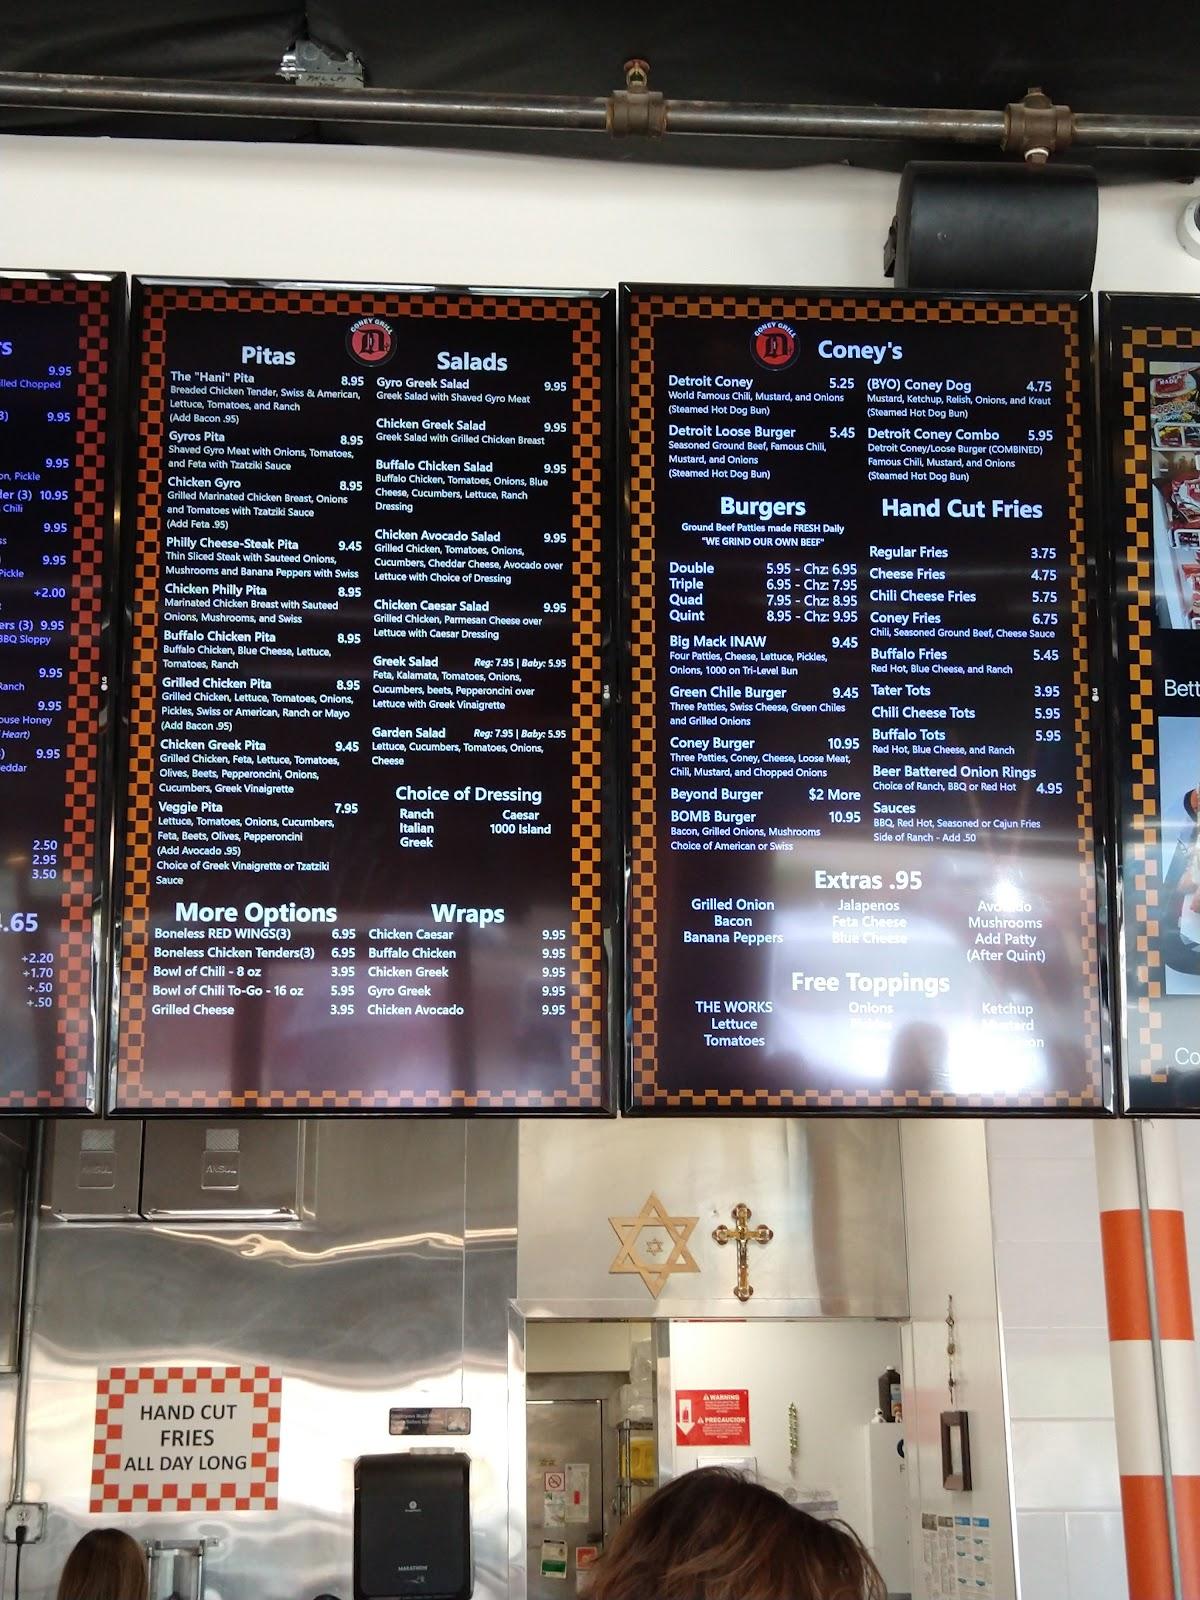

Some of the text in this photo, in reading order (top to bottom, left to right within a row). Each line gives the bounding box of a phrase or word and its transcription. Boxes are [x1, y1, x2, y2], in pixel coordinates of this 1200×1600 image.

[241, 345, 295, 365] Pitas
[818, 340, 903, 364] Coney's
[437, 351, 507, 371] Salads
[48, 366, 71, 376] 9.95
[19, 379, 61, 390] Chopped
[170, 371, 364, 386] The "Hani" Pita 8.95
[376, 377, 566, 391] Gyro Greek Salad 9.95
[668, 375, 854, 390] Detroit Coney 5.25
[867, 378, 1051, 393] (BYO) Coney Dog 4.75
[170, 385, 360, 399] Breaded Chicken Tender, Swiss & American,
[376, 390, 530, 404] Greek Salad with Shaved Gyro Meat
[47, 412, 70, 422] 9.95
[867, 407, 968, 418] (Steamed Hot Dog Bun)
[168, 430, 363, 445] Gyros Pita 8.95
[45, 457, 69, 468] 9.95
[376, 459, 566, 473] Buffalo Chicken Salad 9.95
[14, 471, 40, 480] Pickle
[167, 476, 362, 490] Chicken Gyro 8.95
[17, 489, 68, 501] (3) 10.95
[720, 496, 806, 521] Burgers
[882, 498, 1042, 518] Hand Cut Fries
[43, 522, 67, 532] 9.95
[165, 536, 362, 550] Philly Cheese-Steak Pita 9.45
[869, 545, 1056, 560] Regular Fries 3.75
[42, 555, 66, 565] 9.95
[33, 587, 65, 597] +2.00
[18, 620, 64, 631] (3) 9.95
[19, 634, 51, 645] Sloppy
[670, 635, 858, 649] Big Mack INAW 9.45
[373, 655, 438, 667] Greek Salad
[38, 668, 62, 677] 9.95
[373, 670, 521, 681] Feta, Kalamata, Tomatoes, Onions,
[37, 700, 61, 710] 9.95
[22, 715, 52, 726] Honey
[35, 748, 60, 758] 9.95
[873, 765, 1036, 780] Beer Battered Onion Rings
[1036, 782, 1062, 793] 4.95
[395, 785, 541, 805] Choice of Dressing
[670, 787, 861, 802] Beyond Burger $2 More
[158, 801, 358, 814] Veggie Pita 7.95
[400, 808, 434, 819] Ranch
[502, 809, 539, 820] Caesar
[399, 822, 434, 833] Italian
[489, 823, 551, 834] 1000 Island
[32, 840, 57, 850] 2.50
[400, 836, 433, 847] Greek
[32, 854, 56, 864] 2.95
[31, 869, 56, 879] 3.50
[815, 870, 922, 889] Extras .95
[691, 897, 776, 911] Grilled Onion
[175, 902, 337, 927] More Options
[430, 904, 504, 928] Wraps
[714, 915, 752, 926] Bacon
[968, 916, 1043, 929] Mushrooms
[154, 927, 205, 938] Boneless
[208, 928, 232, 938] RED
[331, 928, 356, 939] 6.95
[684, 931, 785, 945] Banana Peppers
[21, 953, 53, 963] +2.20
[23, 967, 53, 977] +1.70
[367, 984, 565, 998] Gyro Greek 9.95
[792, 972, 951, 998] Free Toppings
[151, 1003, 354, 1014] Grilled Cheese 3.95
[695, 1001, 773, 1013] THE WORKS
[711, 1018, 757, 1029] Lettuce
[703, 1035, 765, 1047] Tomatoes
[140, 1404, 237, 1420] HAND CUT
[161, 1429, 214, 1446] FRIES
[124, 1455, 246, 1470] ALL DAY LONG
